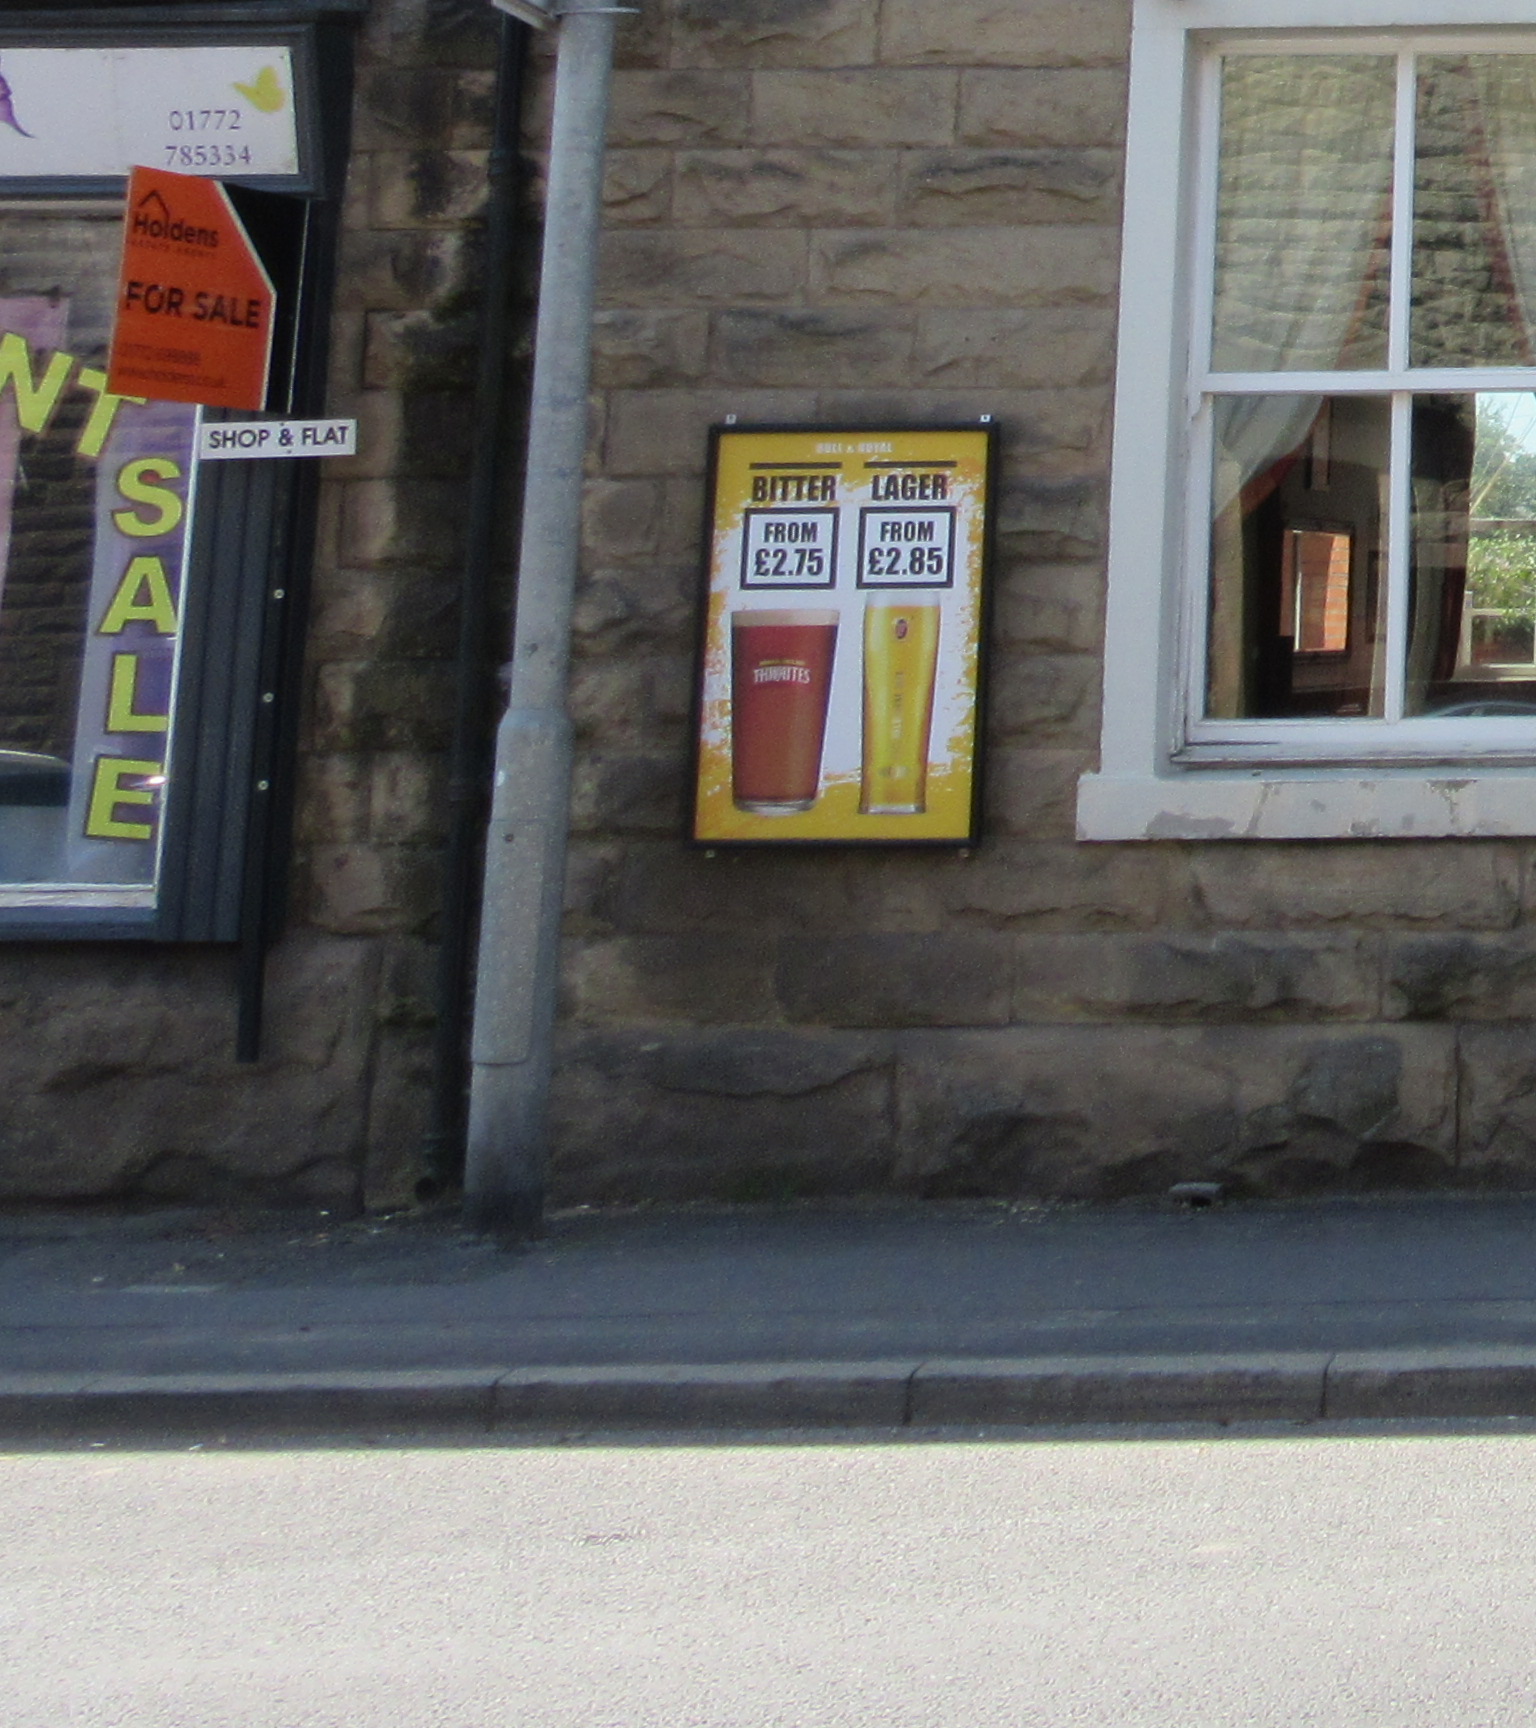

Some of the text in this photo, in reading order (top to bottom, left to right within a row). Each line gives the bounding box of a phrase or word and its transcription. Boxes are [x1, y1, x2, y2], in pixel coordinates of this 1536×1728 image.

[169, 110, 242, 131] 01772
[164, 145, 252, 167] 785334
[132, 212, 219, 248] Holdens
[125, 280, 261, 328] FOR SALE
[208, 426, 349, 449] SHOP & FLAT
[752, 475, 836, 502] BITTER
[871, 474, 948, 501] LAGER
[764, 522, 818, 543] FROM
[880, 521, 934, 542] FROM
[754, 548, 824, 577] £2.75
[868, 547, 943, 575] £2.85
[84, 458, 184, 840] SALE
